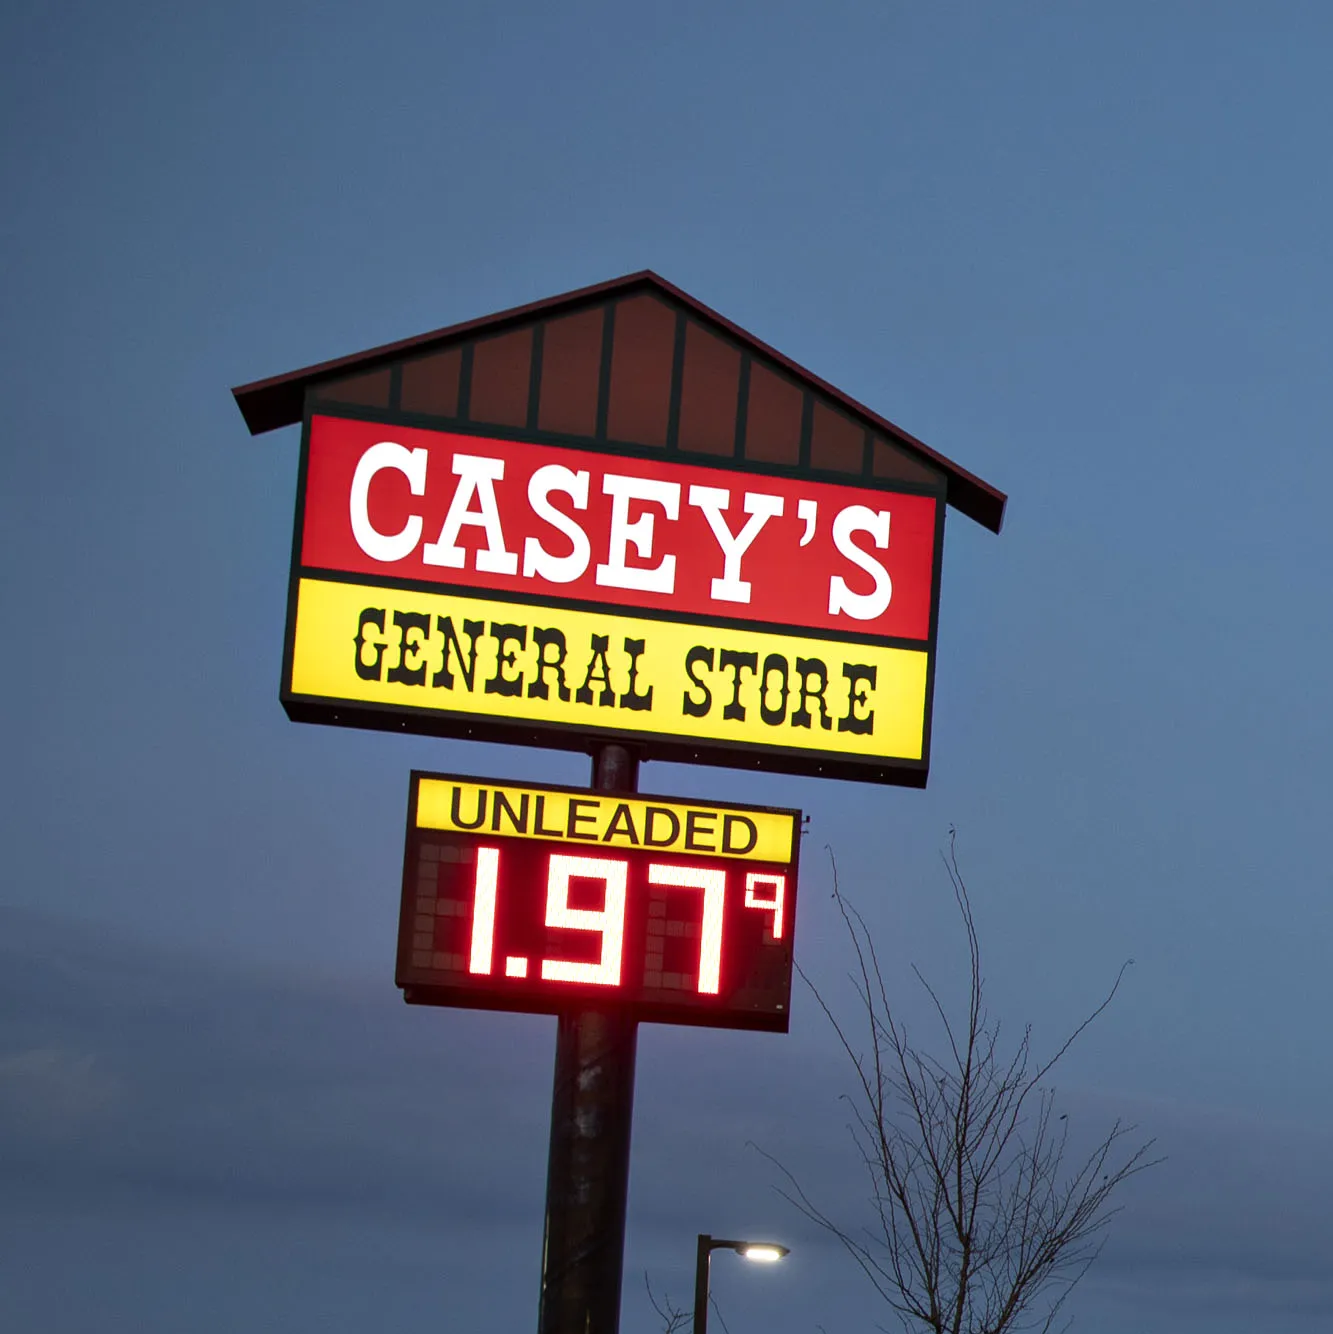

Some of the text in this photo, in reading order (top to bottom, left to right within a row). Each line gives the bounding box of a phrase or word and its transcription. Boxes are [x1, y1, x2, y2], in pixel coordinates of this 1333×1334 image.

[349, 441, 893, 621] CASEY'S
[353, 606, 877, 736] GENERAL STORE
[449, 786, 759, 856] UNLEADED
